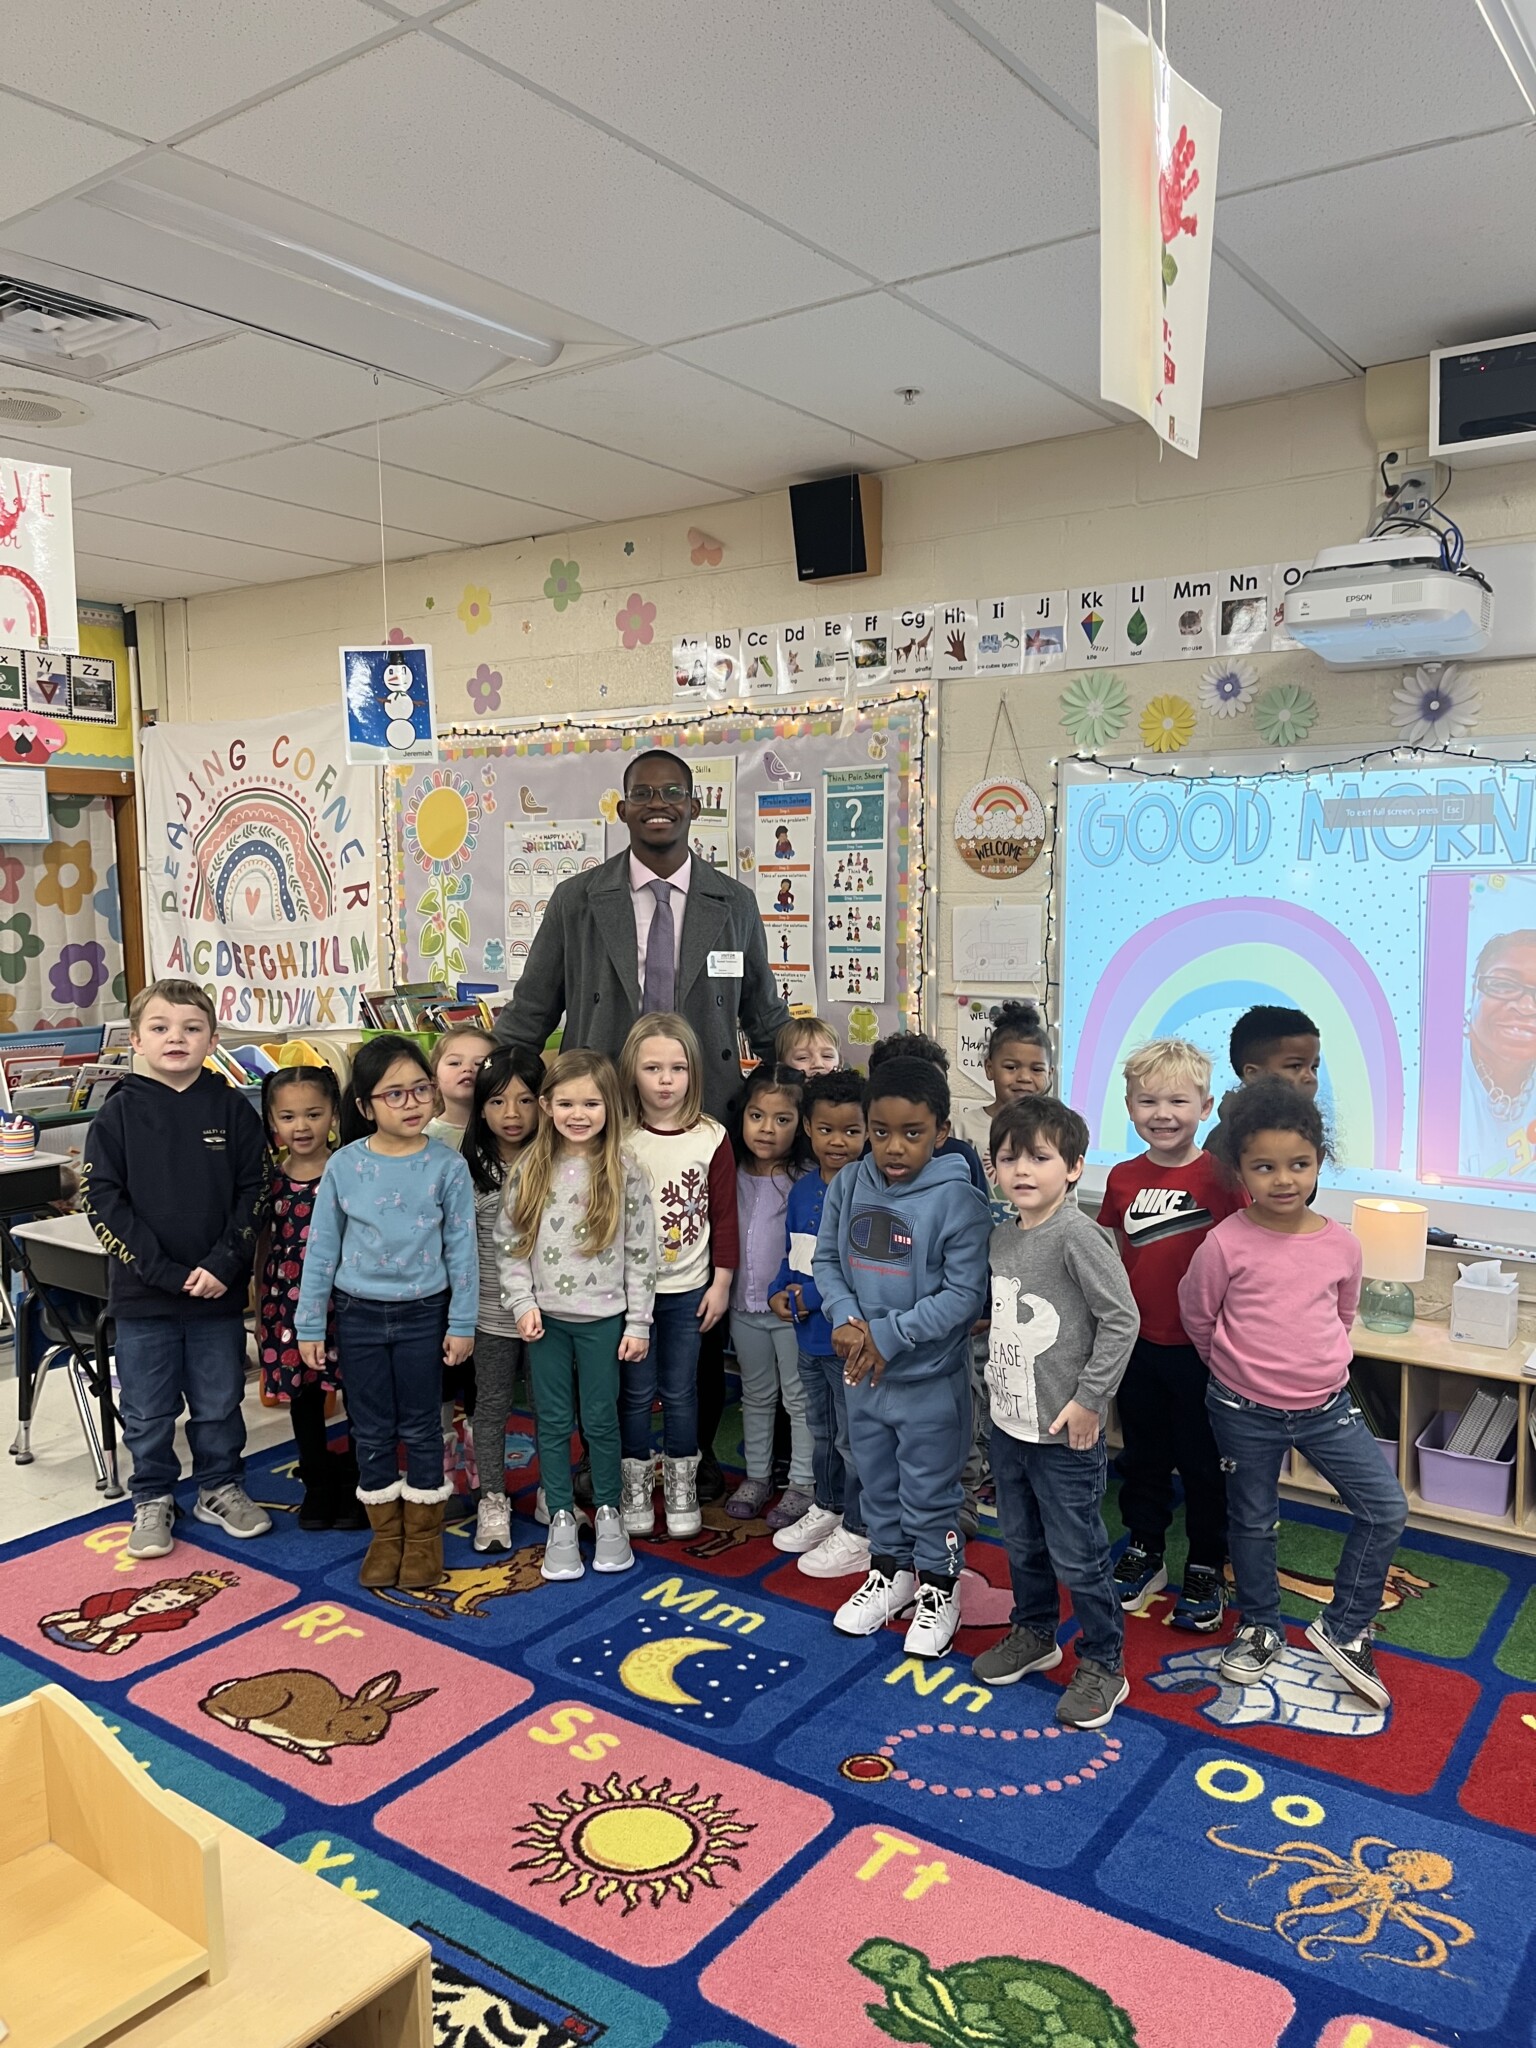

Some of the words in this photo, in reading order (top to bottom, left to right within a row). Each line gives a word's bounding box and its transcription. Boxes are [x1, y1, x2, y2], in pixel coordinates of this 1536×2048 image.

[1173, 581, 1211, 599] Mm
[1229, 574, 1258, 592] Nn
[1081, 591, 1103, 609] Kk
[1131, 585, 1144, 603] Ll
[1345, 594, 1373, 603] EPSON
[944, 607, 966, 624] Hh
[992, 602, 1004, 619] Ii
[1037, 598, 1050, 618] Jj
[824, 621, 842, 636] Ee
[865, 616, 878, 631] Ff
[901, 611, 925, 628] Gg
[715, 634, 731, 649] Bb
[747, 632, 768, 647] Cc
[785, 626, 805, 643] Dd
[37, 656, 53, 672] Yy
[82, 664, 99, 677] Zz
[403, 750, 433, 758] Jeremiah
[1346, 808, 1355, 817] To
[1357, 807, 1371, 817] exit
[1373, 807, 1386, 816] full
[1417, 806, 1439, 816] press
[1446, 805, 1460, 815] Esc
[161, 739, 247, 913] READING
[272, 735, 371, 911] CORNER
[1078, 786, 1272, 868] GOOD
[1297, 777, 1536, 864] MORN
[975, 840, 1024, 862] WELCOME
[970, 1012, 991, 1021] WEL
[963, 1059, 983, 1067] CLA
[1131, 1188, 1187, 1213] NIKE
[95, 1222, 136, 1265] CREW
[988, 1364, 1009, 1389] THE
[642, 1577, 766, 1634] Mm
[282, 1605, 364, 1645] Rr
[884, 1658, 993, 1713] Nn
[528, 1707, 620, 1761] Ss
[1195, 1759, 1325, 1827] Oo
[855, 1831, 951, 1900] Tt
